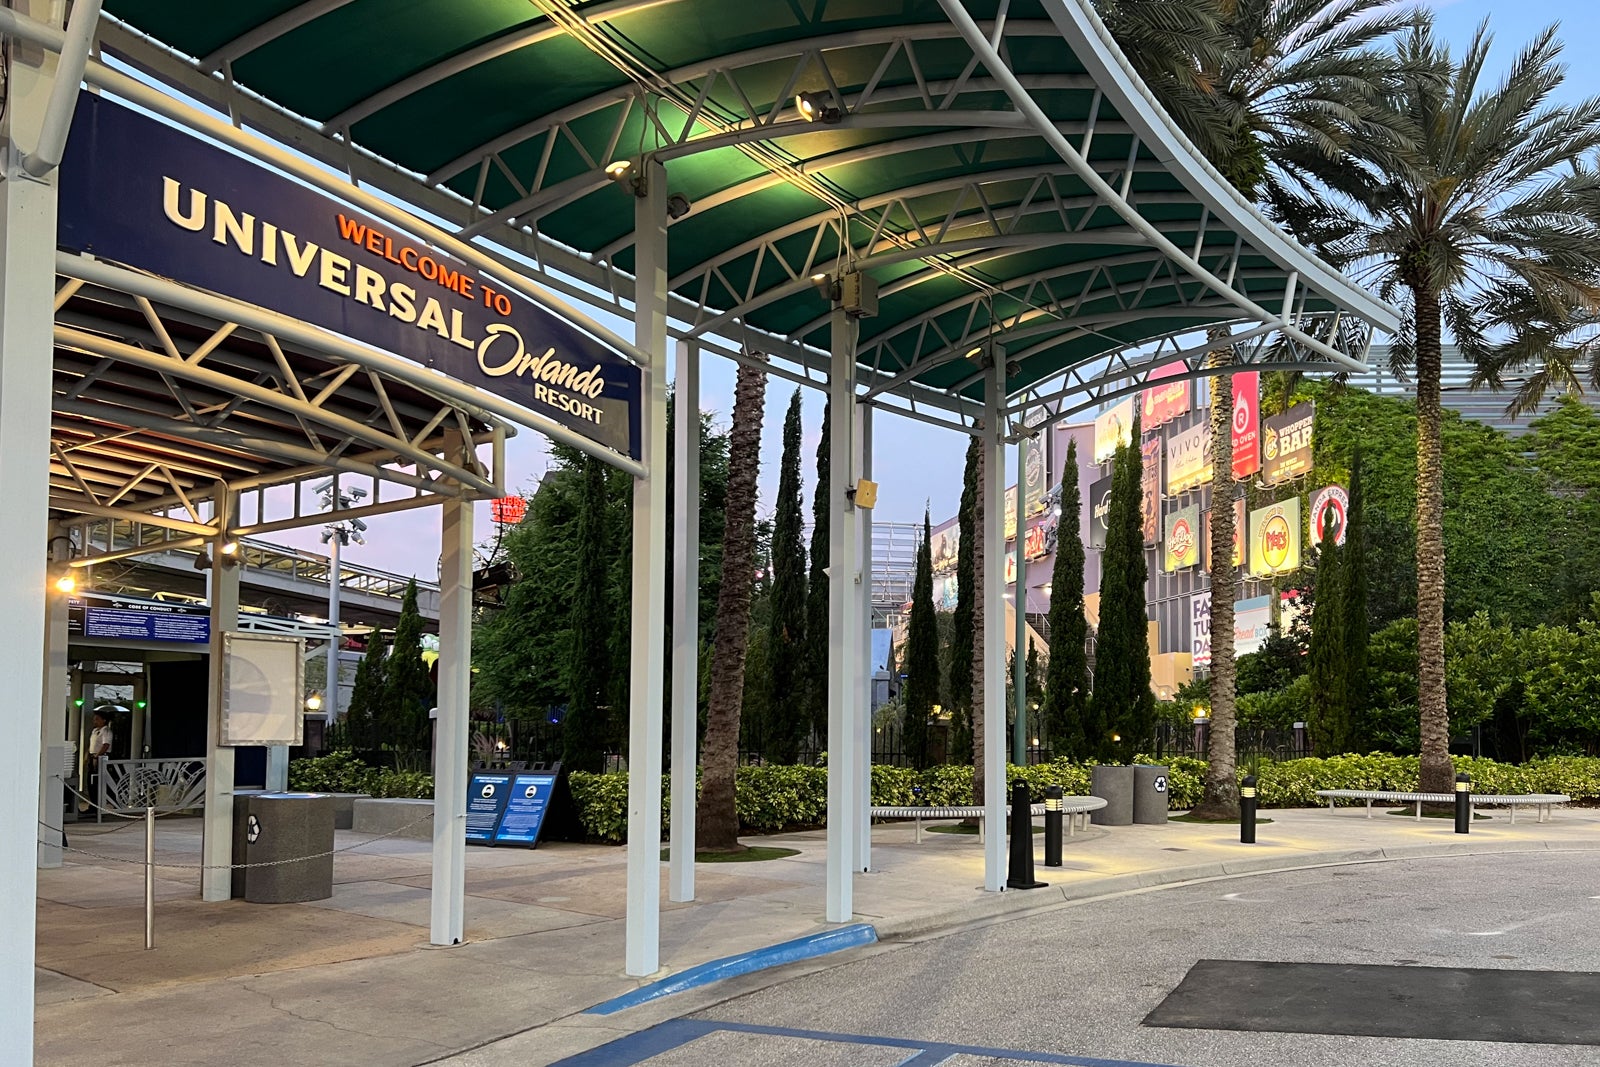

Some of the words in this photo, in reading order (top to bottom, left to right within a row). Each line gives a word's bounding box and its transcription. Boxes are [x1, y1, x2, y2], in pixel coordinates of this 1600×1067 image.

[162, 176, 476, 350] UNIVERSAL
[337, 213, 475, 300] WELCOME
[480, 284, 512, 316] TO
[477, 323, 605, 399] Orlando
[534, 382, 604, 425] RESORT
[1240, 430, 1256, 445] OVEN
[1279, 416, 1312, 438] WHOPPER
[1171, 435, 1200, 459] VIVO
[1280, 426, 1313, 458] BAR
[1311, 494, 1327, 525] PANDA
[1327, 489, 1349, 508] EXPRES
[1193, 598, 1211, 620] FA
[1193, 620, 1211, 637] TU
[1193, 639, 1211, 657] DA
